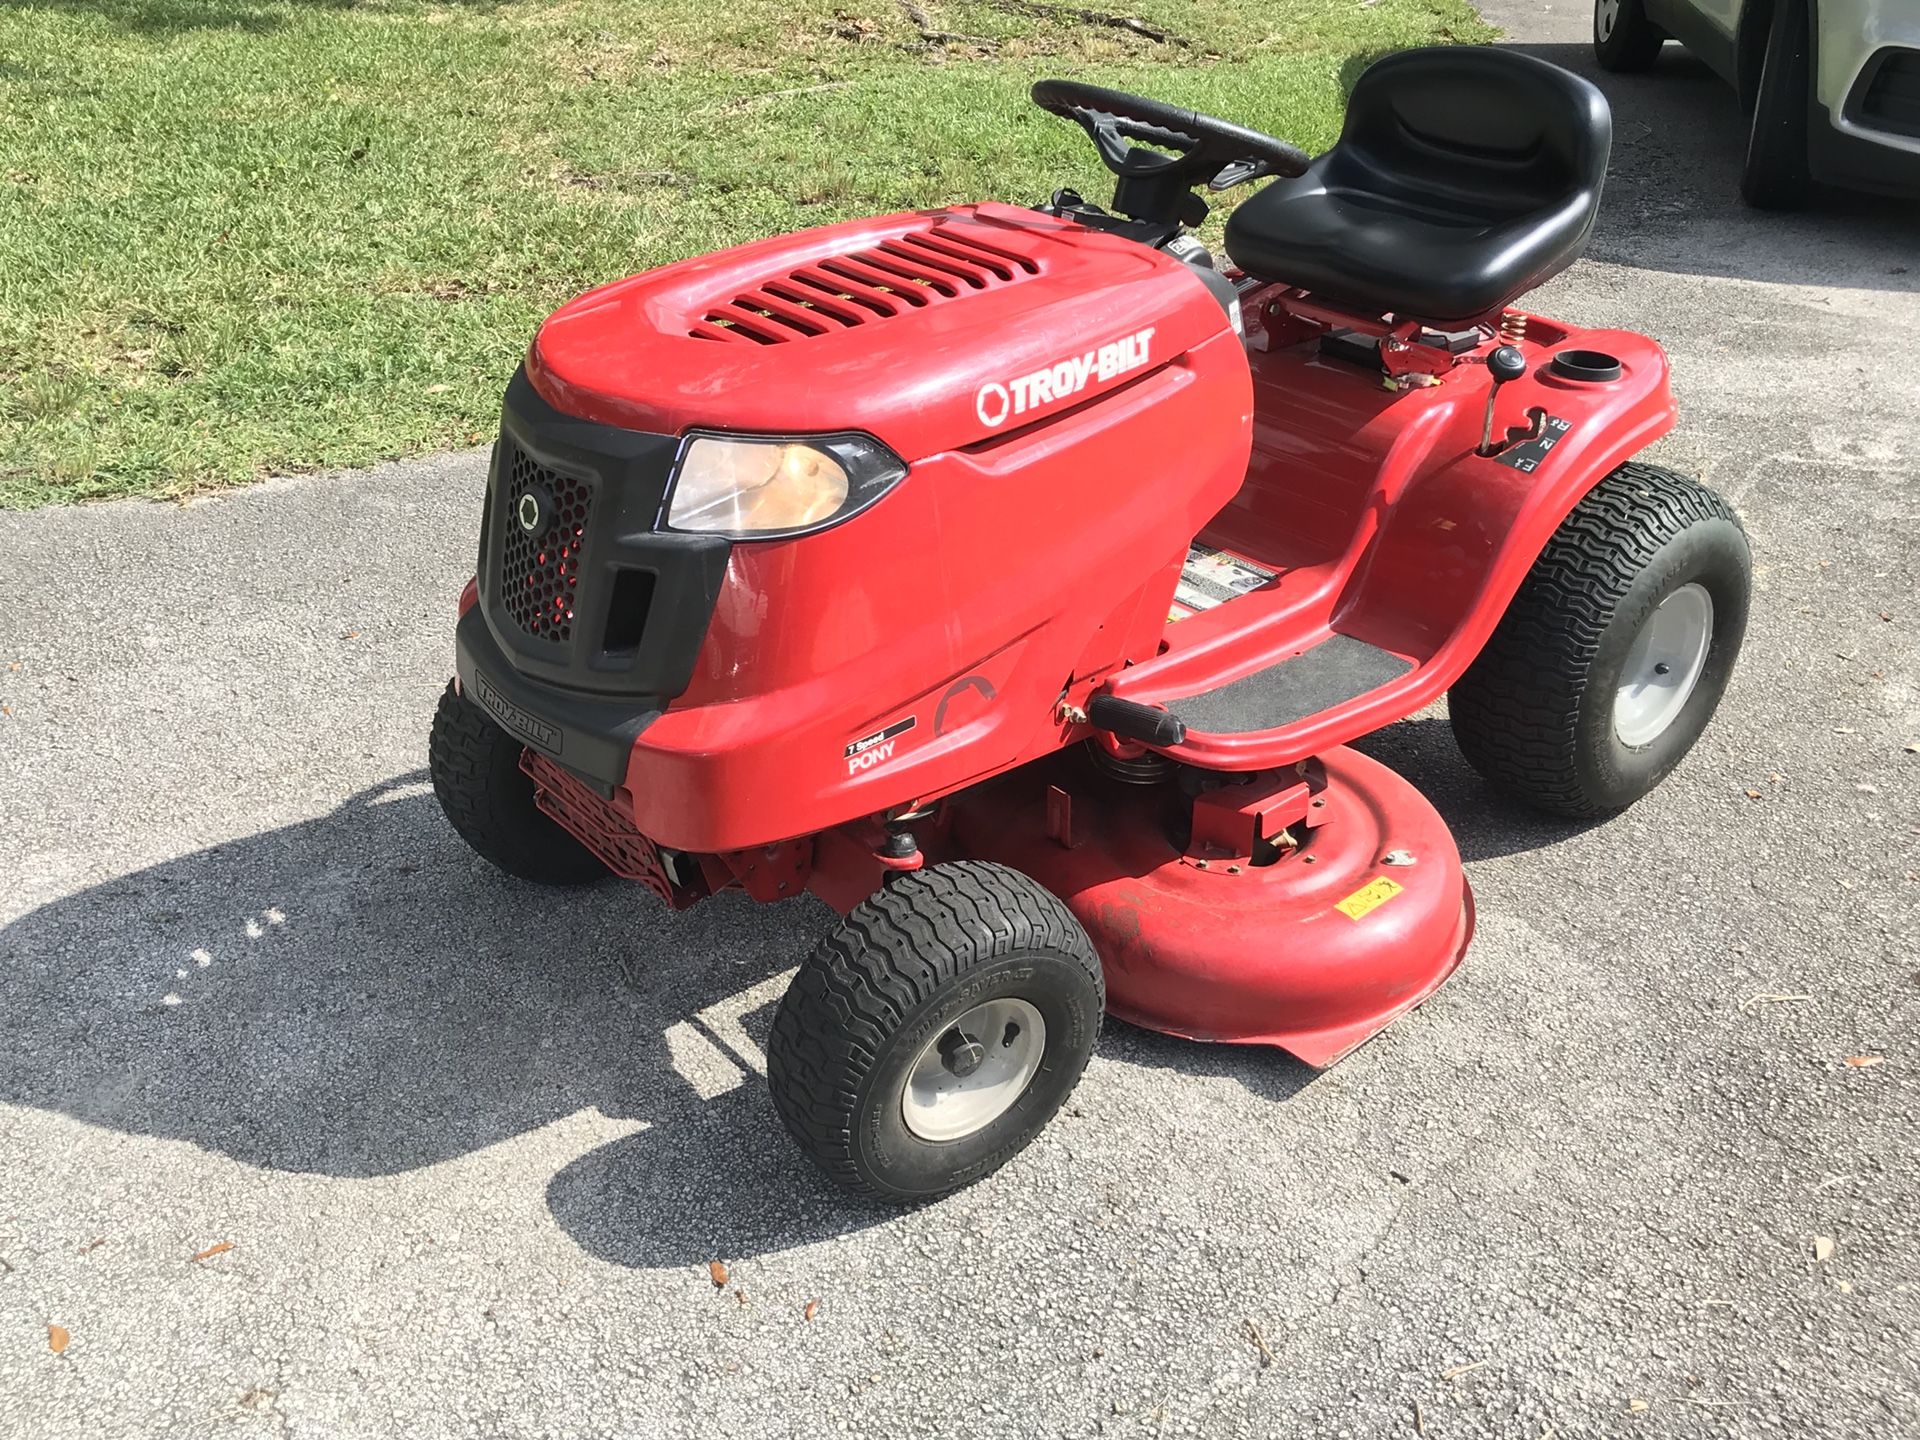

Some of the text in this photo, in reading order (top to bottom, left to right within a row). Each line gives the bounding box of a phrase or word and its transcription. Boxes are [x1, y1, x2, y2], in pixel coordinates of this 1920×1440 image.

[1009, 328, 1153, 414] TROY-BILT
[480, 679, 554, 745] TROY-BILT
[848, 732, 885, 754] 7 Speed
[848, 740, 896, 775] PONY
